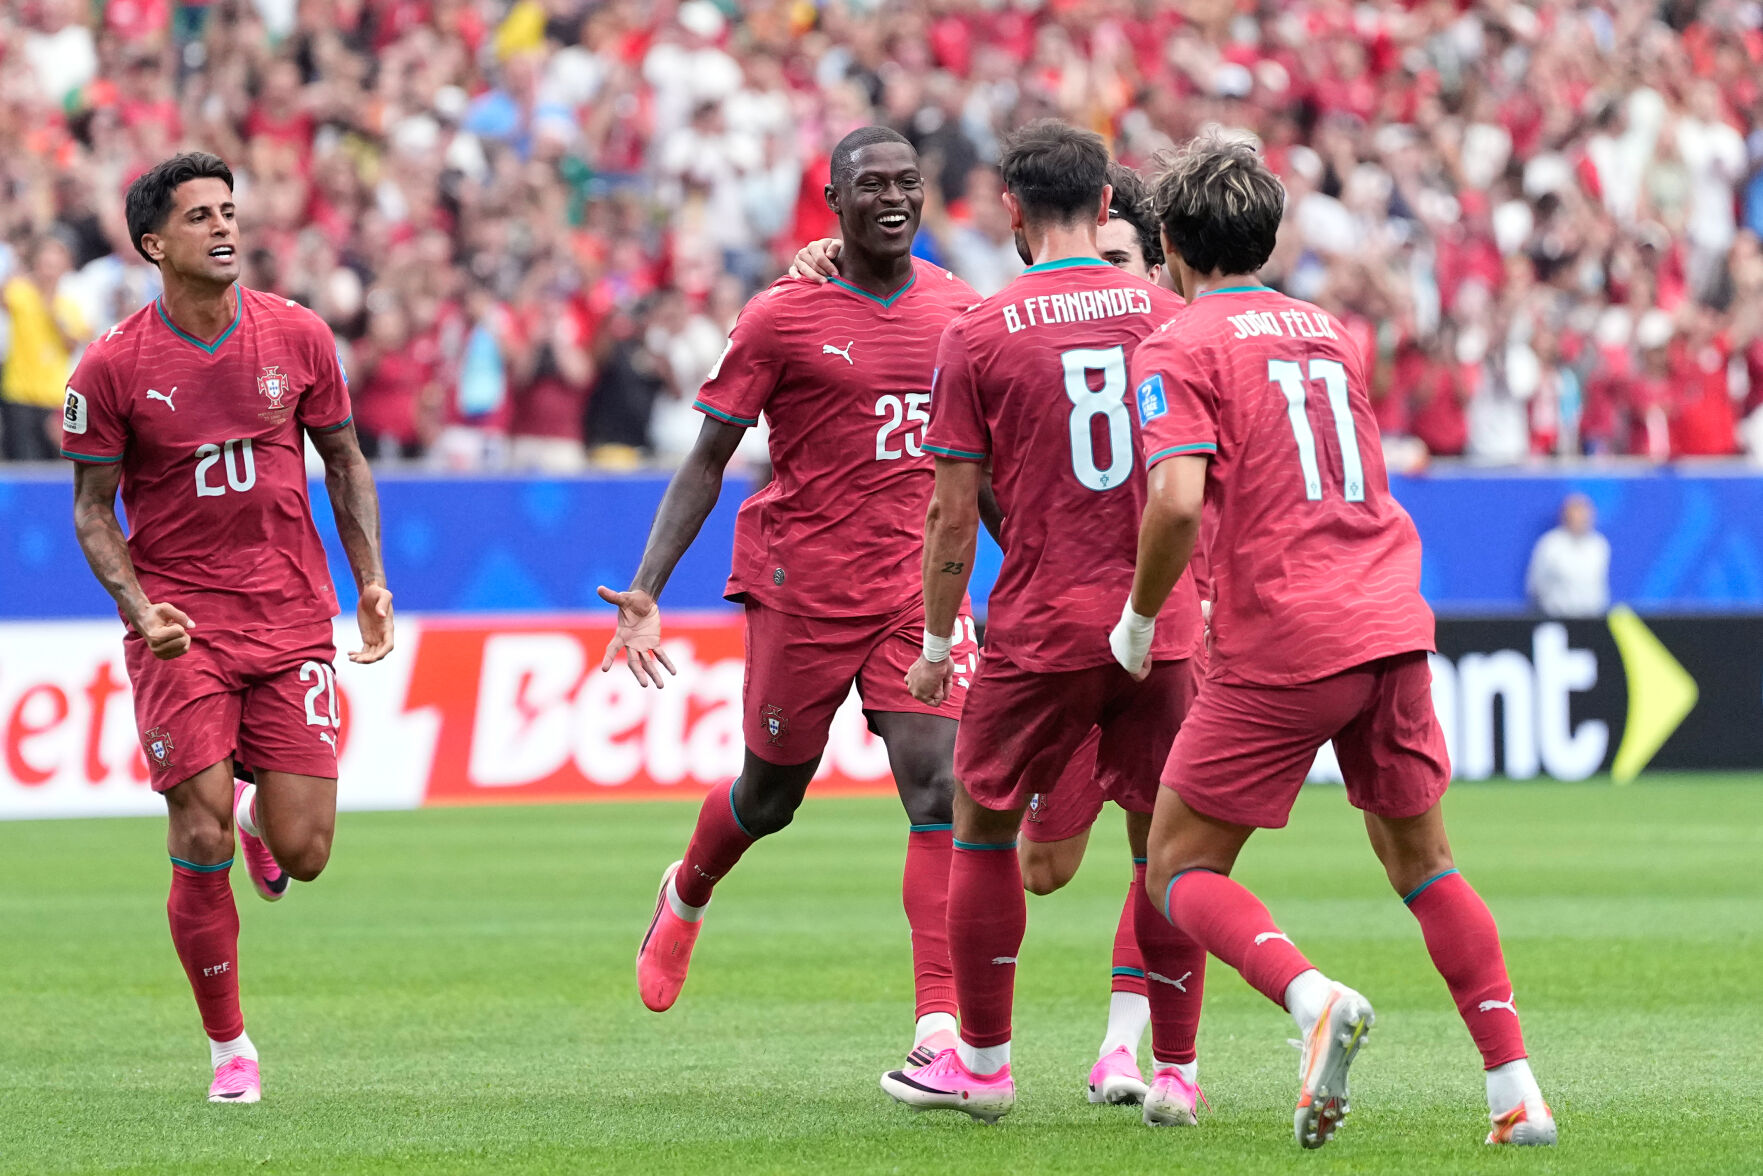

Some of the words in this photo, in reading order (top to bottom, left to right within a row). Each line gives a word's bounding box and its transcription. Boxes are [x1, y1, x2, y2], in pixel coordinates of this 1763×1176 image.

[1280, 308, 1338, 340] FÉLIX
[875, 392, 930, 461] 25
[1061, 344, 1134, 491] 8
[1268, 359, 1365, 502] 11
[195, 438, 256, 497] 20
[941, 561, 964, 575] 23
